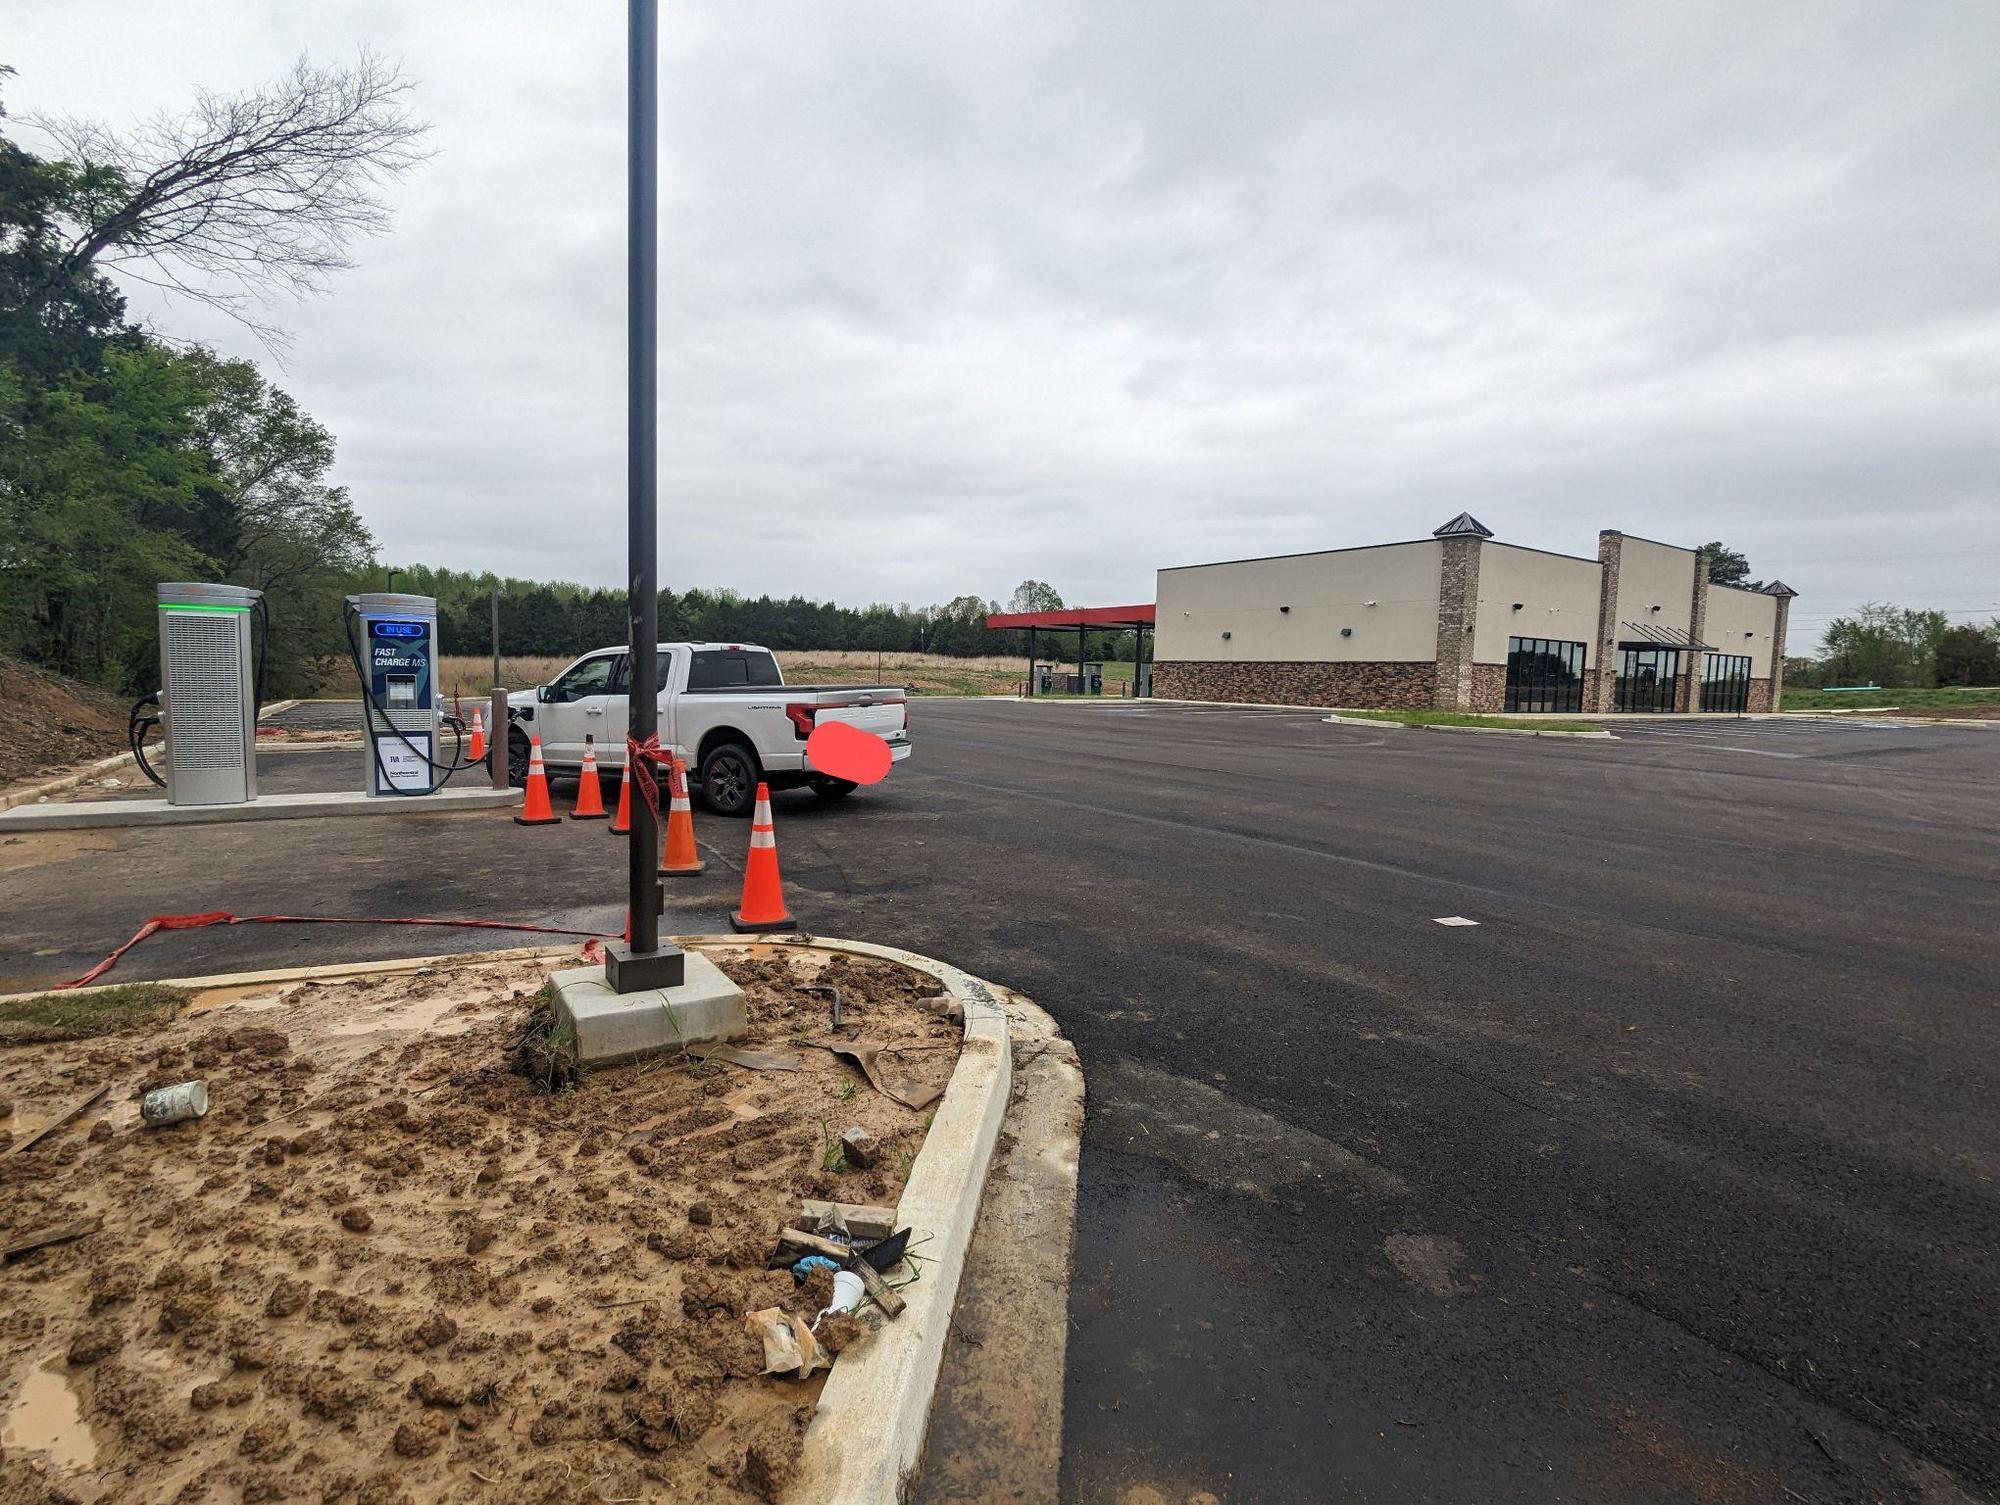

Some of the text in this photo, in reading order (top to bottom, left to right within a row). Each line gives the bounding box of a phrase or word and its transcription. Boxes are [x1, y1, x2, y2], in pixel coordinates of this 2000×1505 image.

[396, 626, 412, 634] USE
[374, 647, 396, 656] FAST
[375, 657, 427, 668] CHARGE MS
